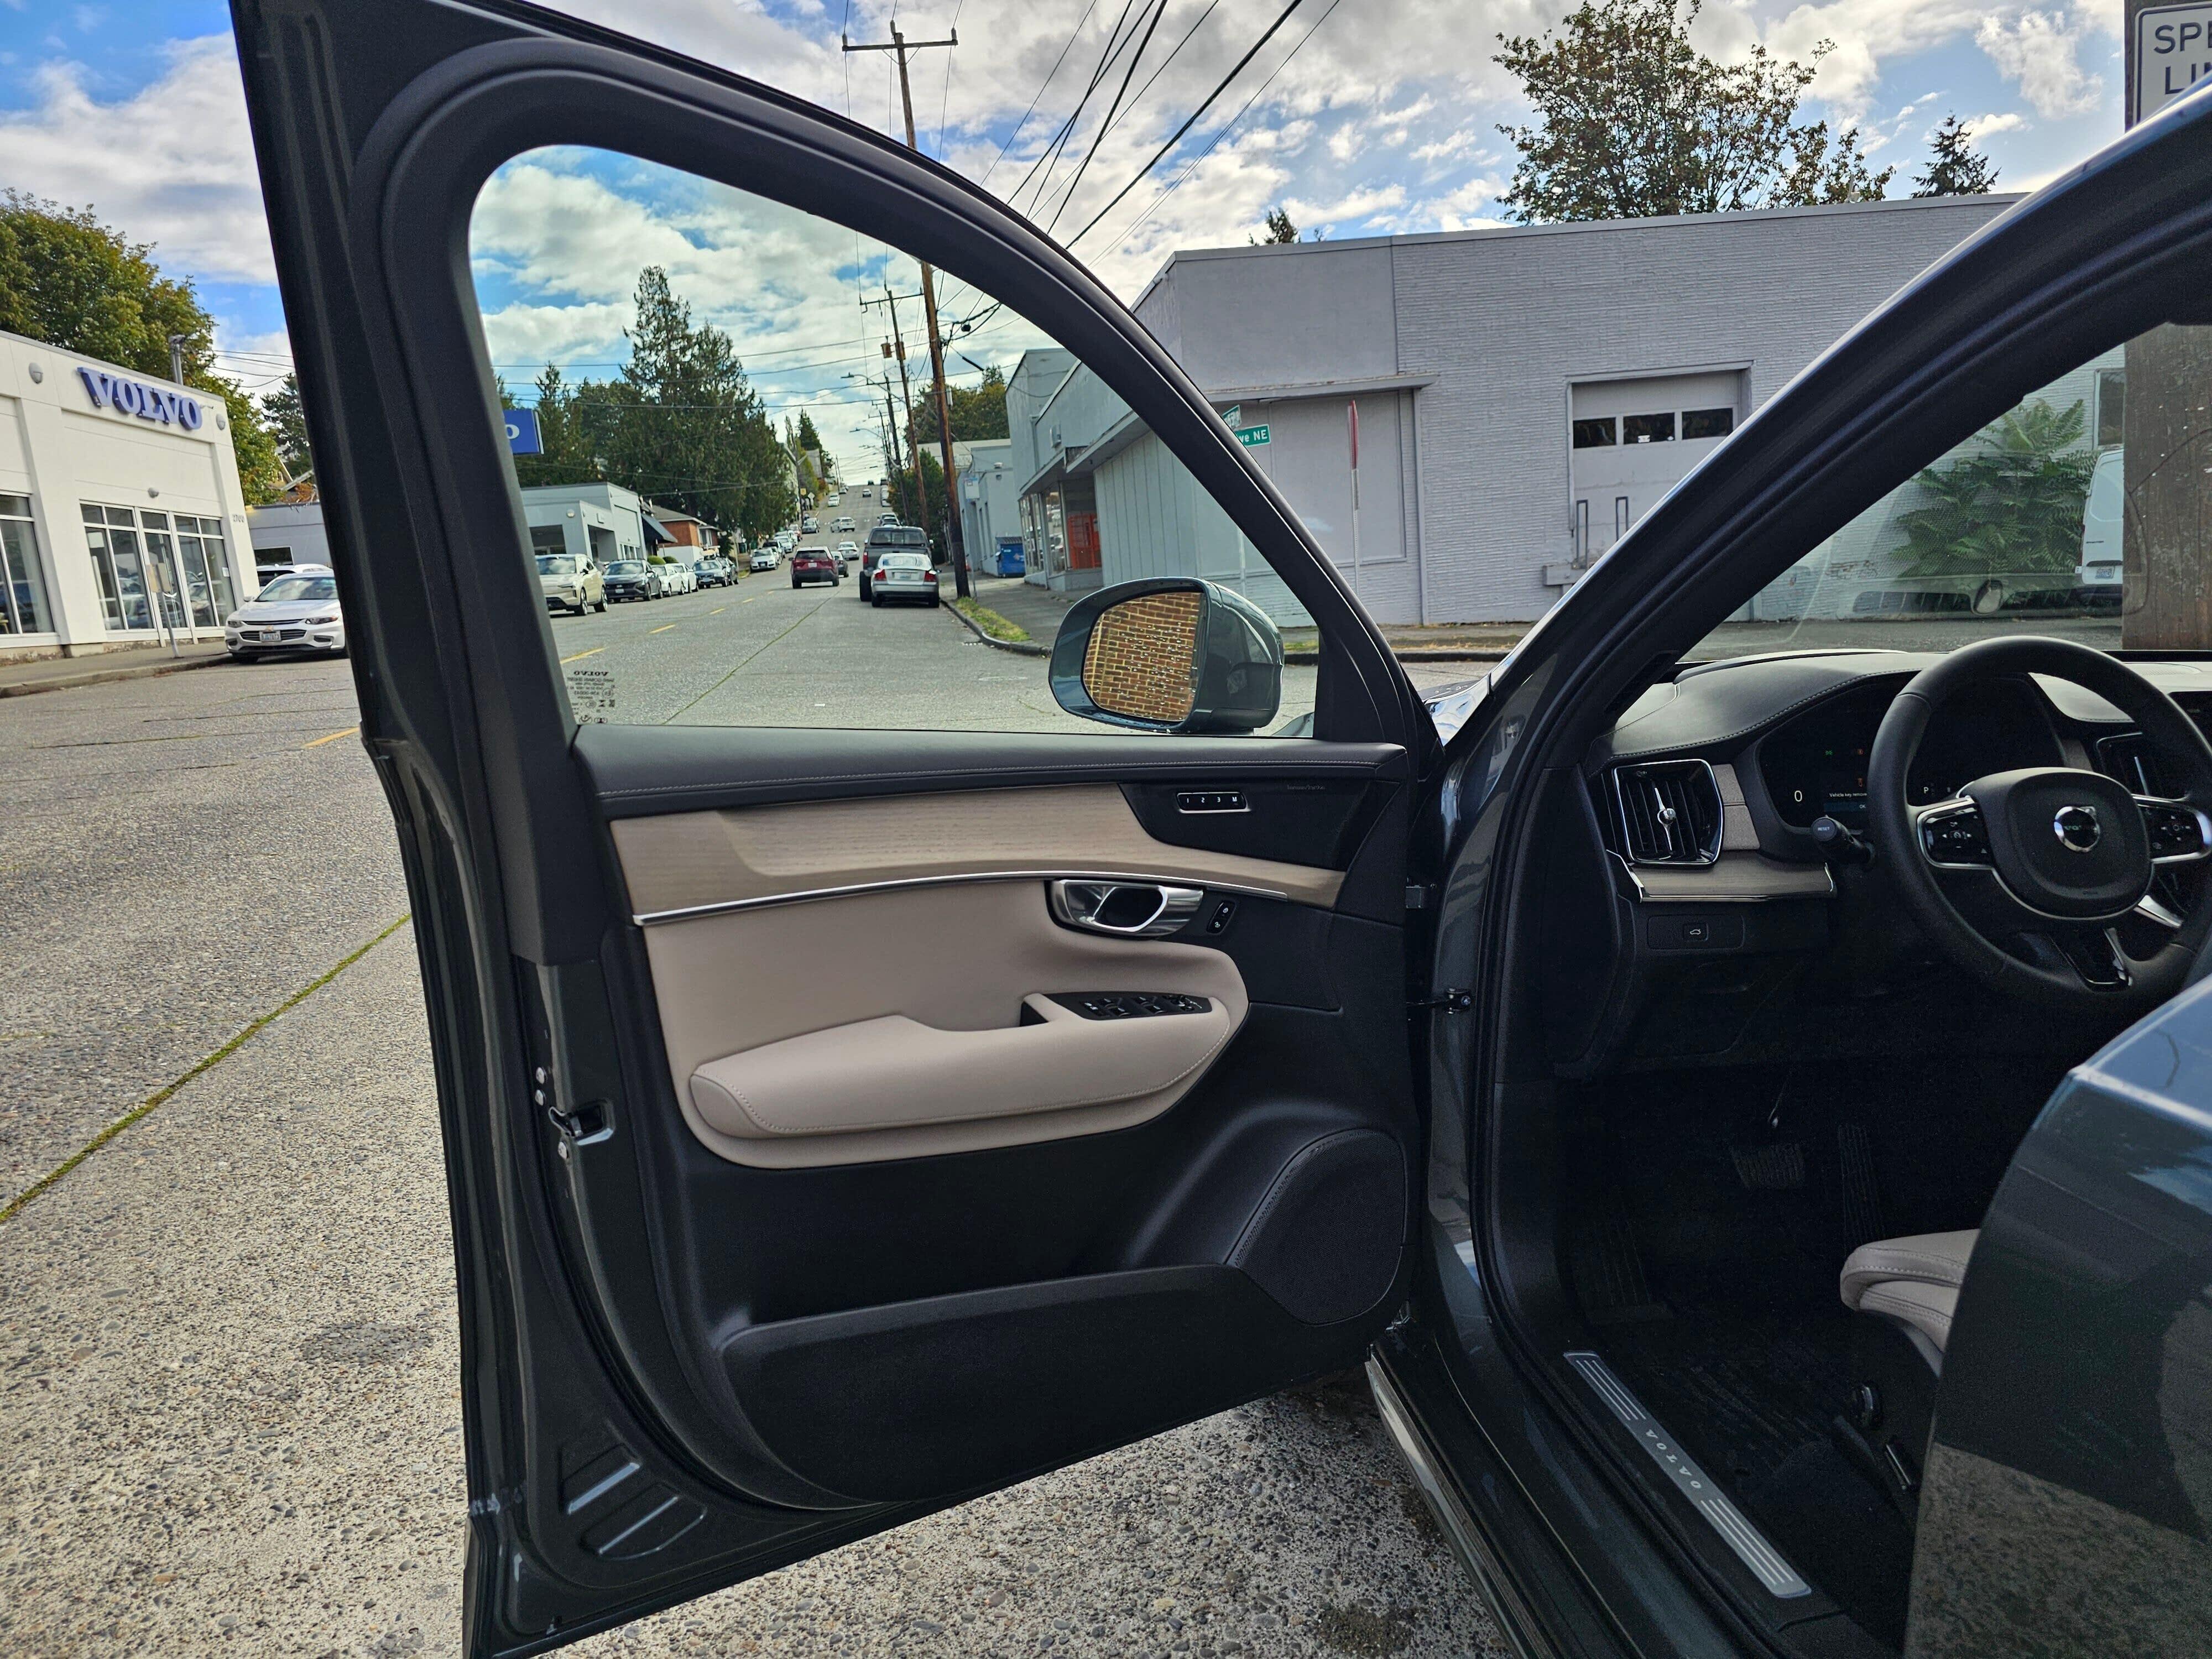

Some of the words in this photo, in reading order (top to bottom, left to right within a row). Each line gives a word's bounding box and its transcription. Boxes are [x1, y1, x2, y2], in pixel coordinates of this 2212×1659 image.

[2165, 61, 2212, 95] LI
[77, 367, 202, 430] VOLVO
[1239, 434, 1250, 443] ve
[1253, 430, 1267, 441] NE
[1794, 790, 1802, 802] 0
[1646, 1429, 1702, 1489] VOLVO
